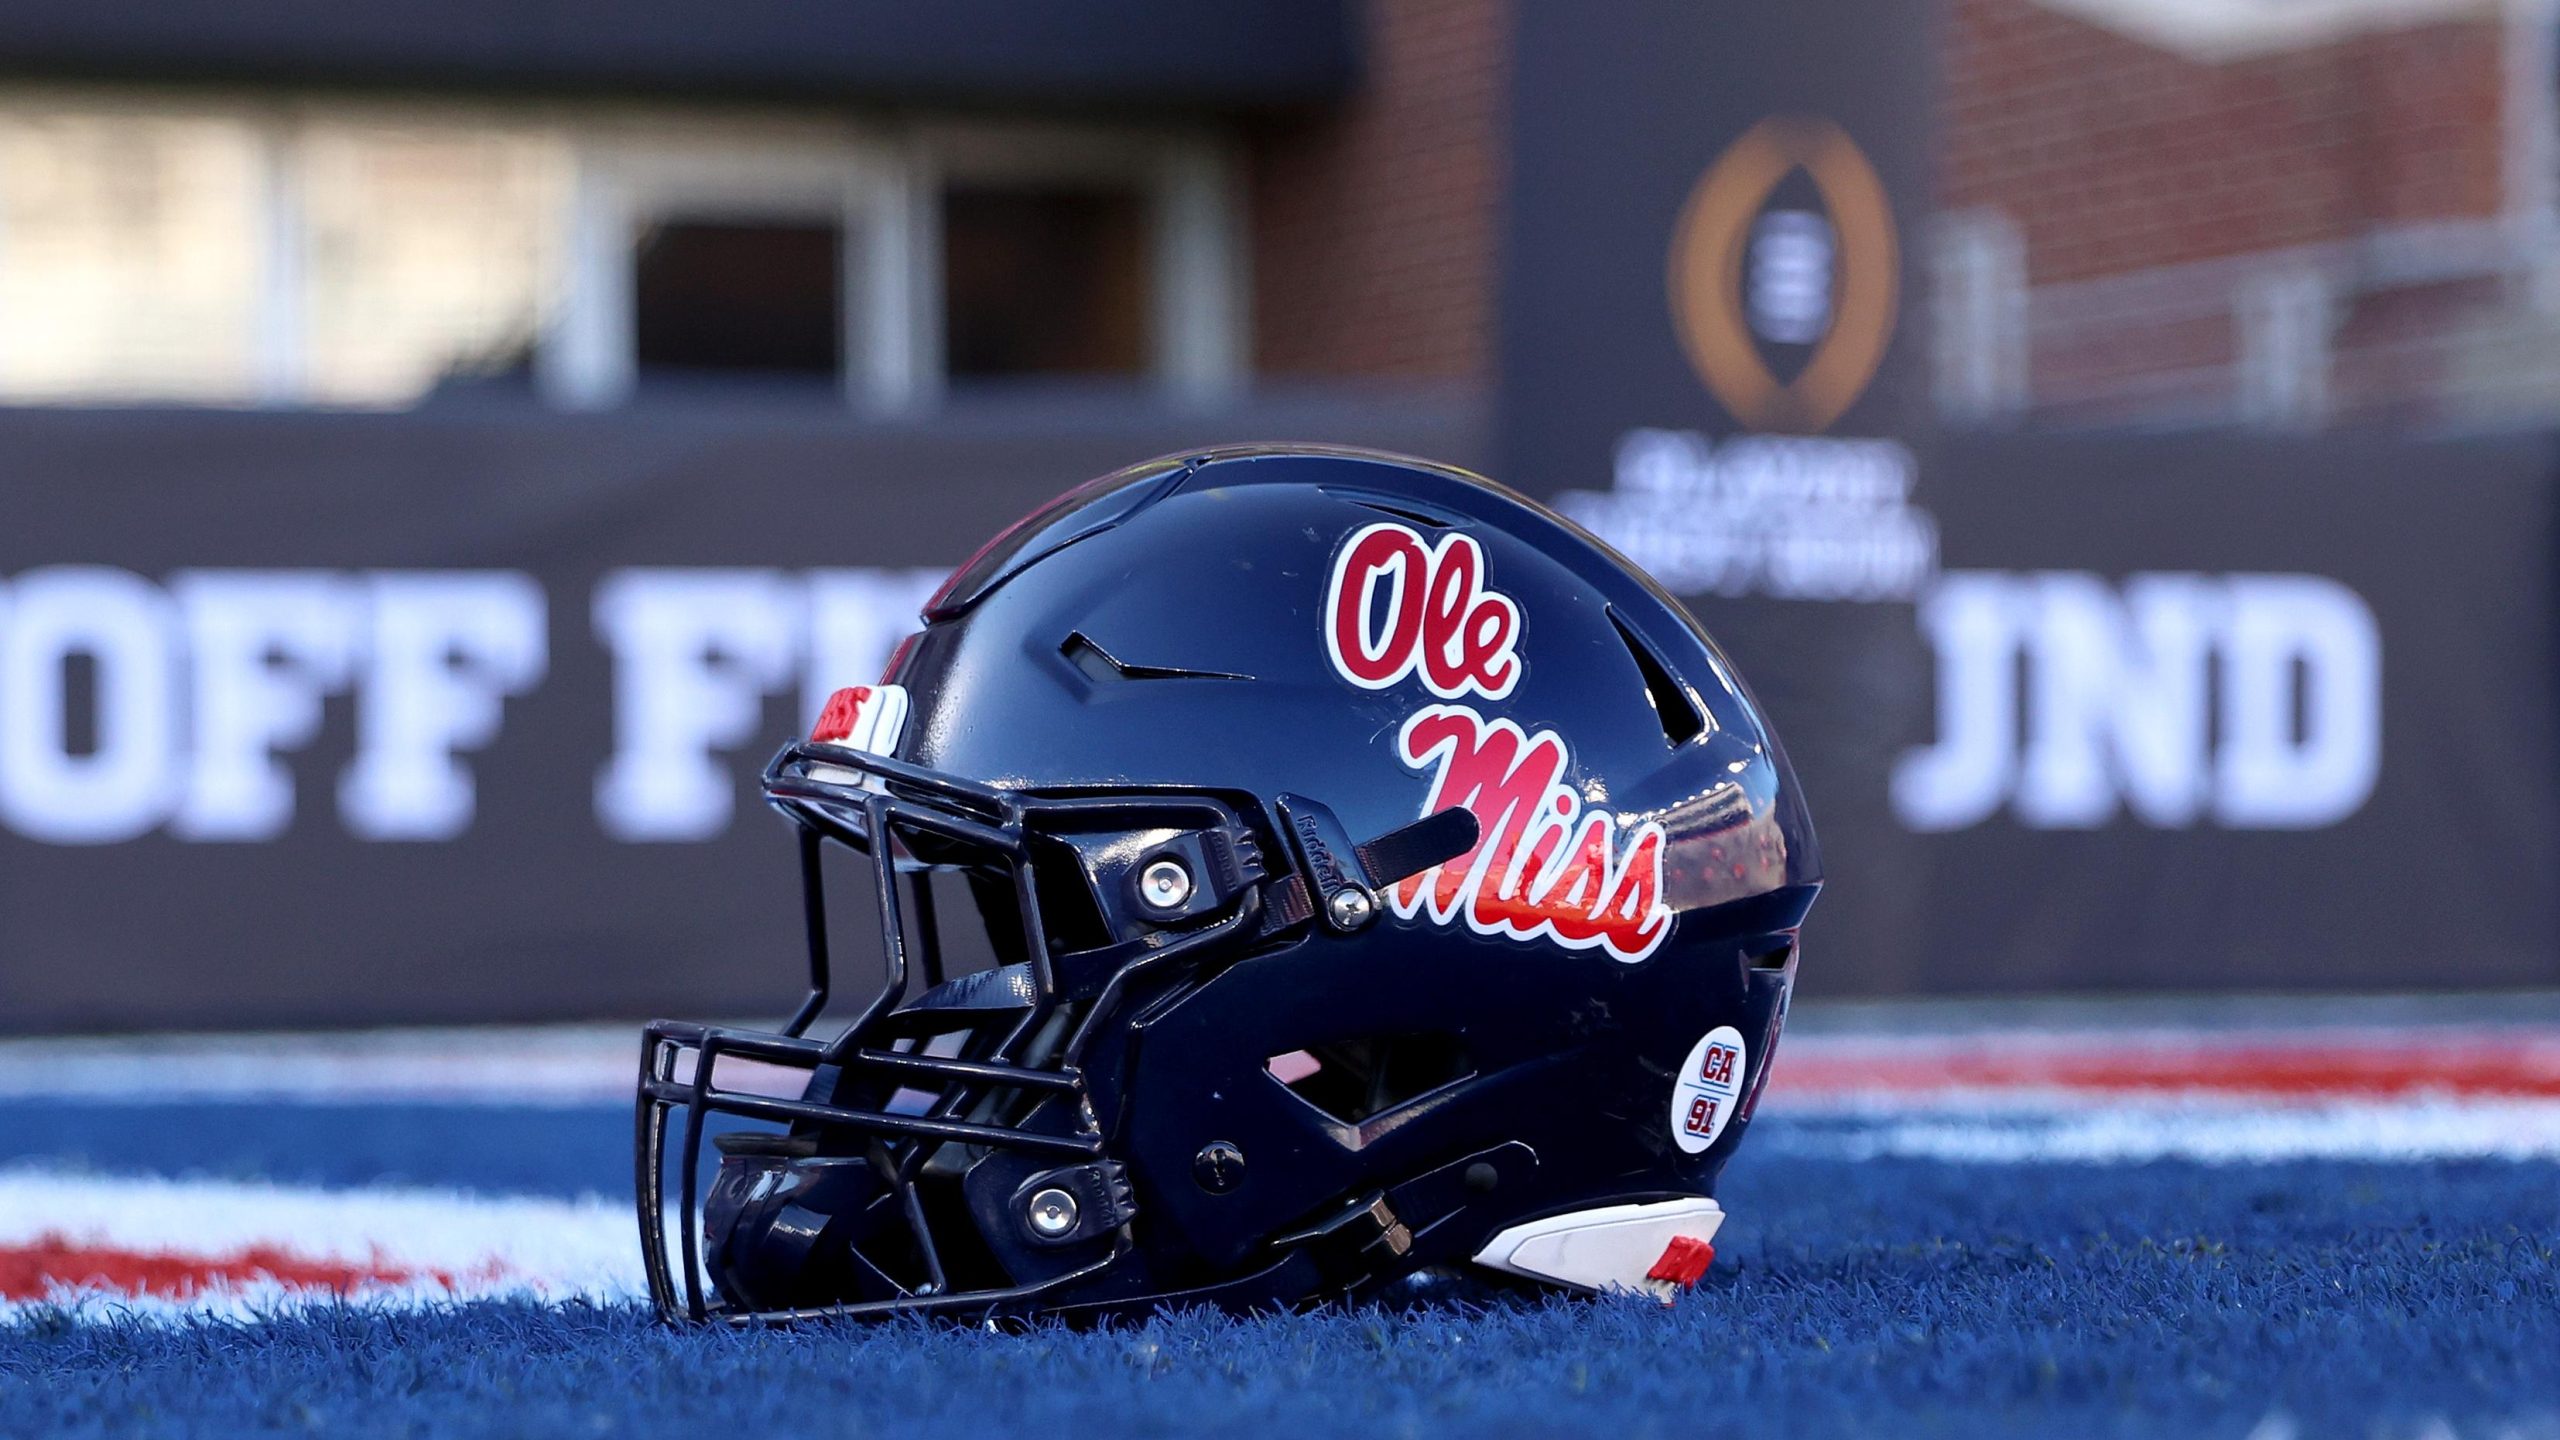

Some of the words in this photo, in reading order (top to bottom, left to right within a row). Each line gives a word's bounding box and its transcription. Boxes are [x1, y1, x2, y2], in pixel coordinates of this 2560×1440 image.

[1326, 523, 1521, 699] Ole
[1390, 704, 1672, 963] Miss
[1684, 1094, 1721, 1139] 91
[1700, 1041, 1739, 1088] CA
